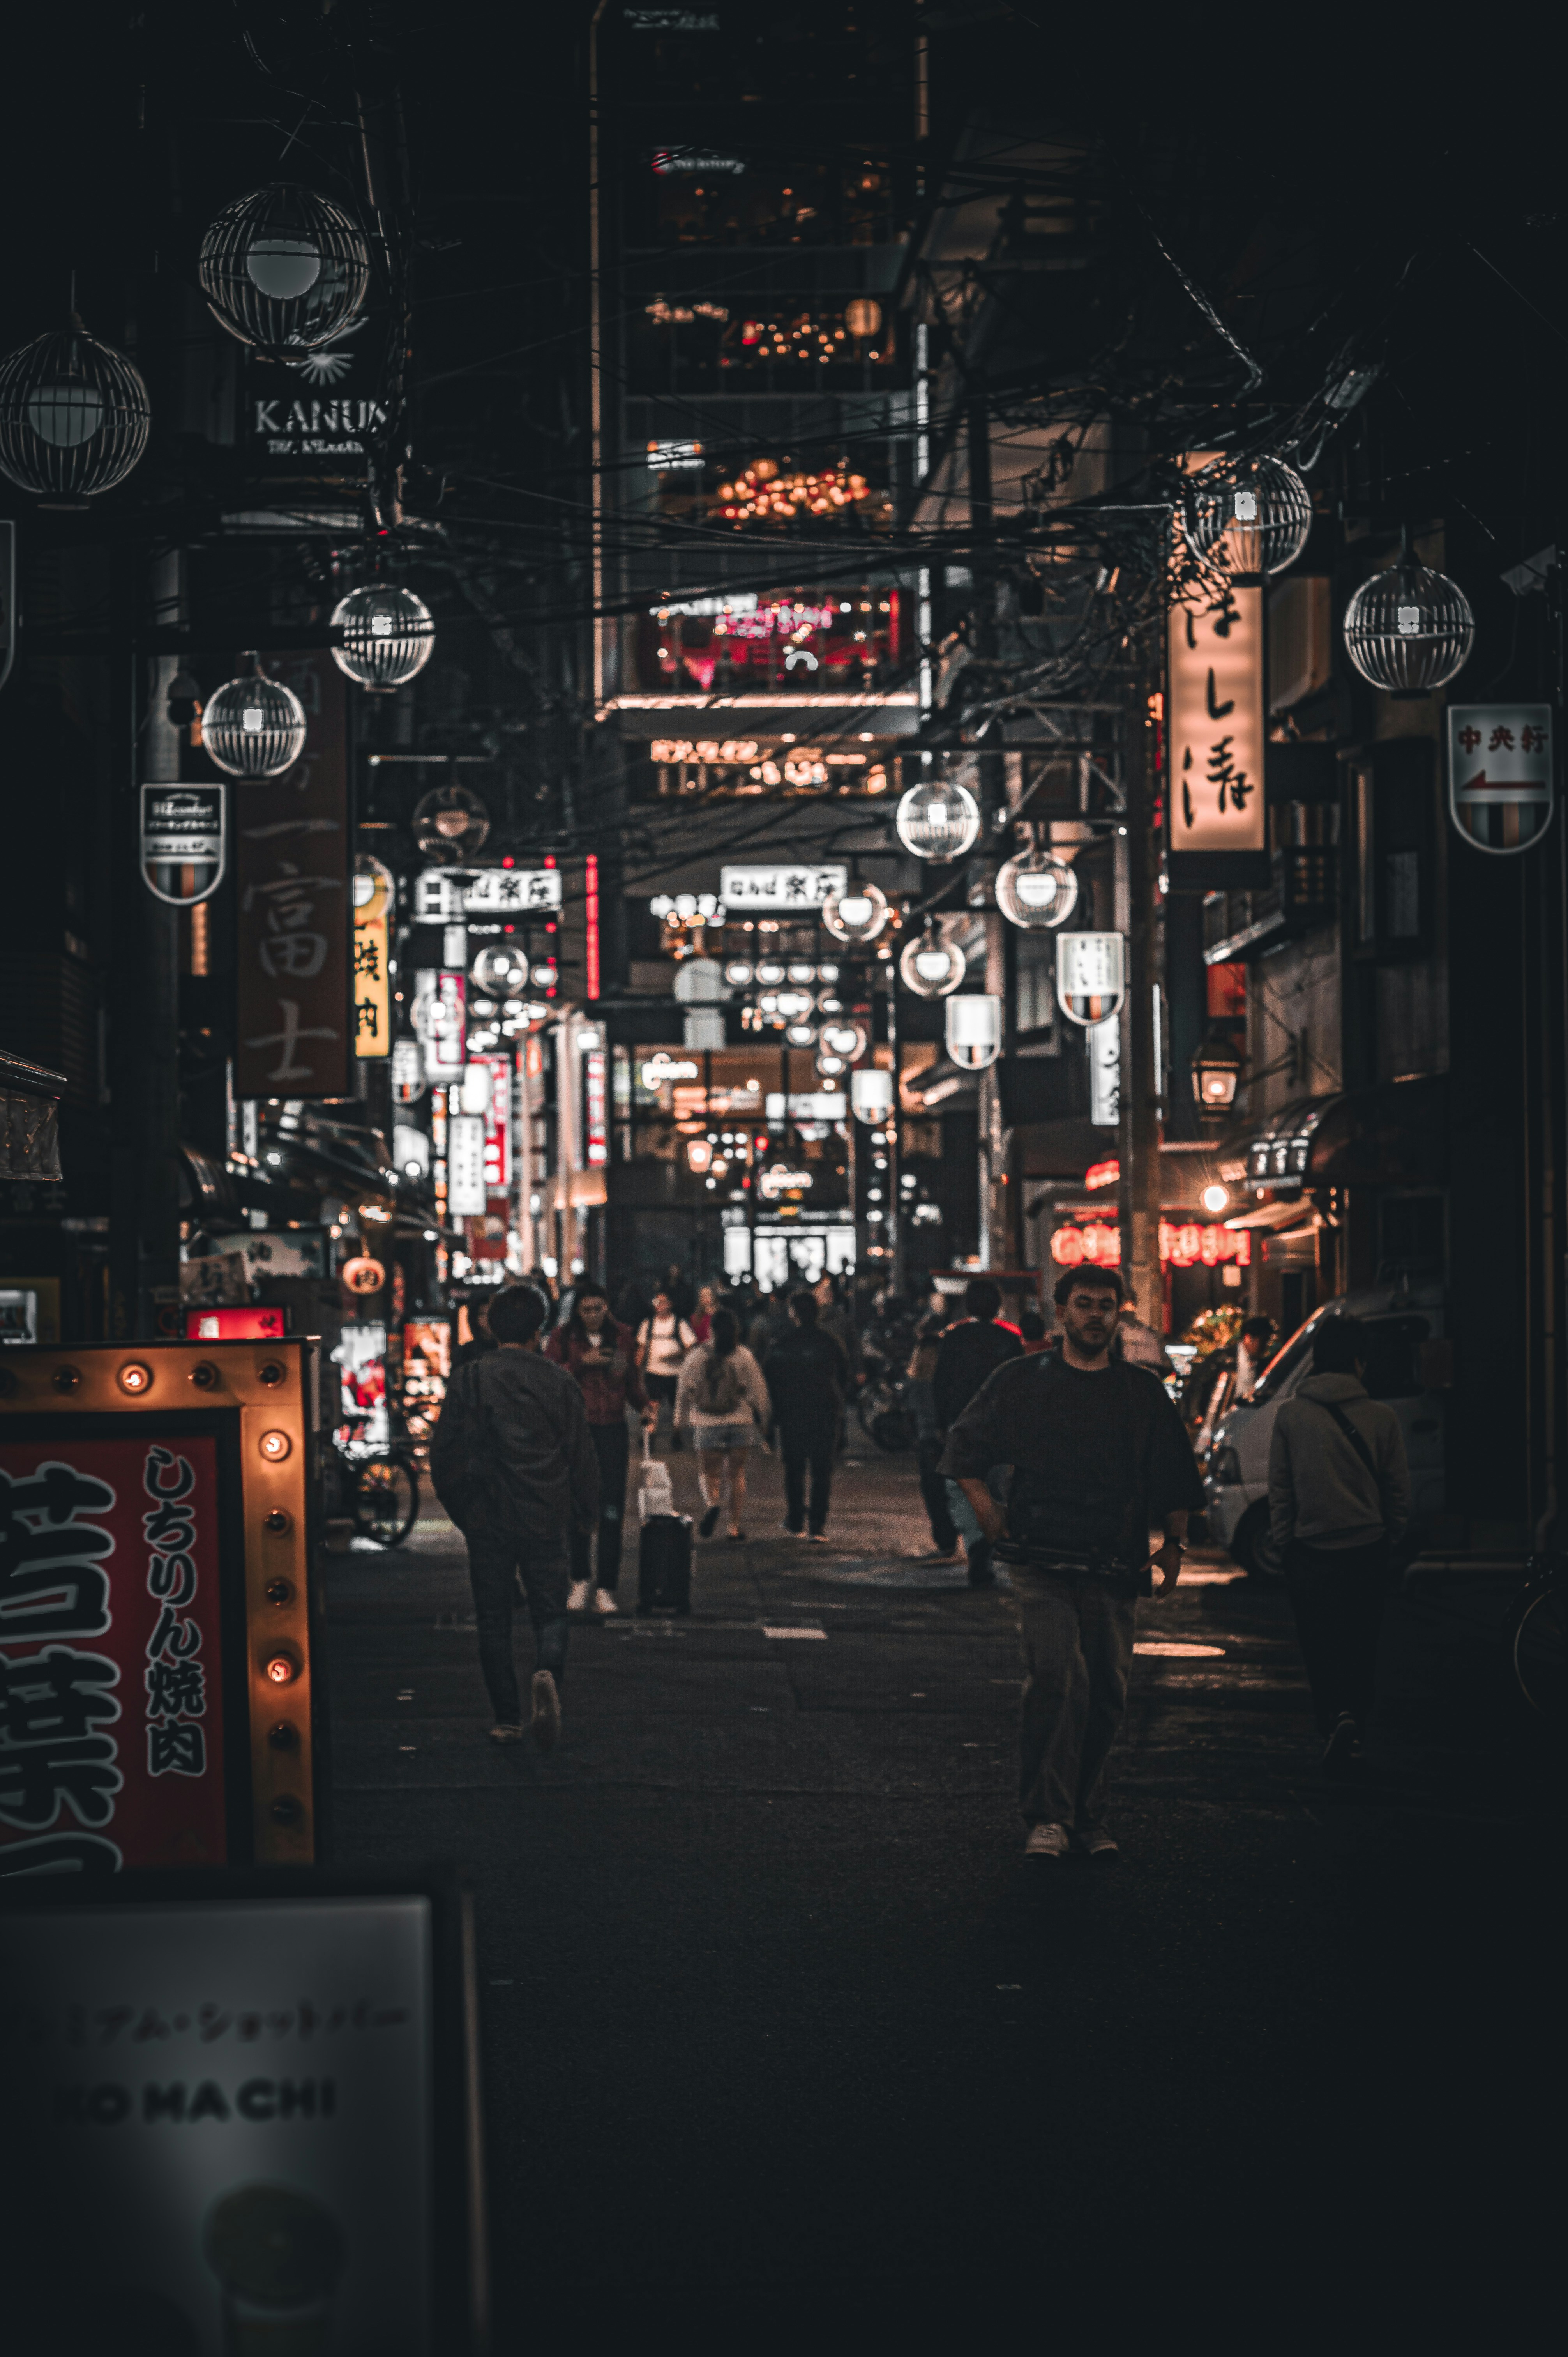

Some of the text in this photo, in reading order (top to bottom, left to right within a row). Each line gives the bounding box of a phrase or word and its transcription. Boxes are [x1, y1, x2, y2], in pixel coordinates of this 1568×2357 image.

[142, 1445, 208, 1778] しちりん焼肉
